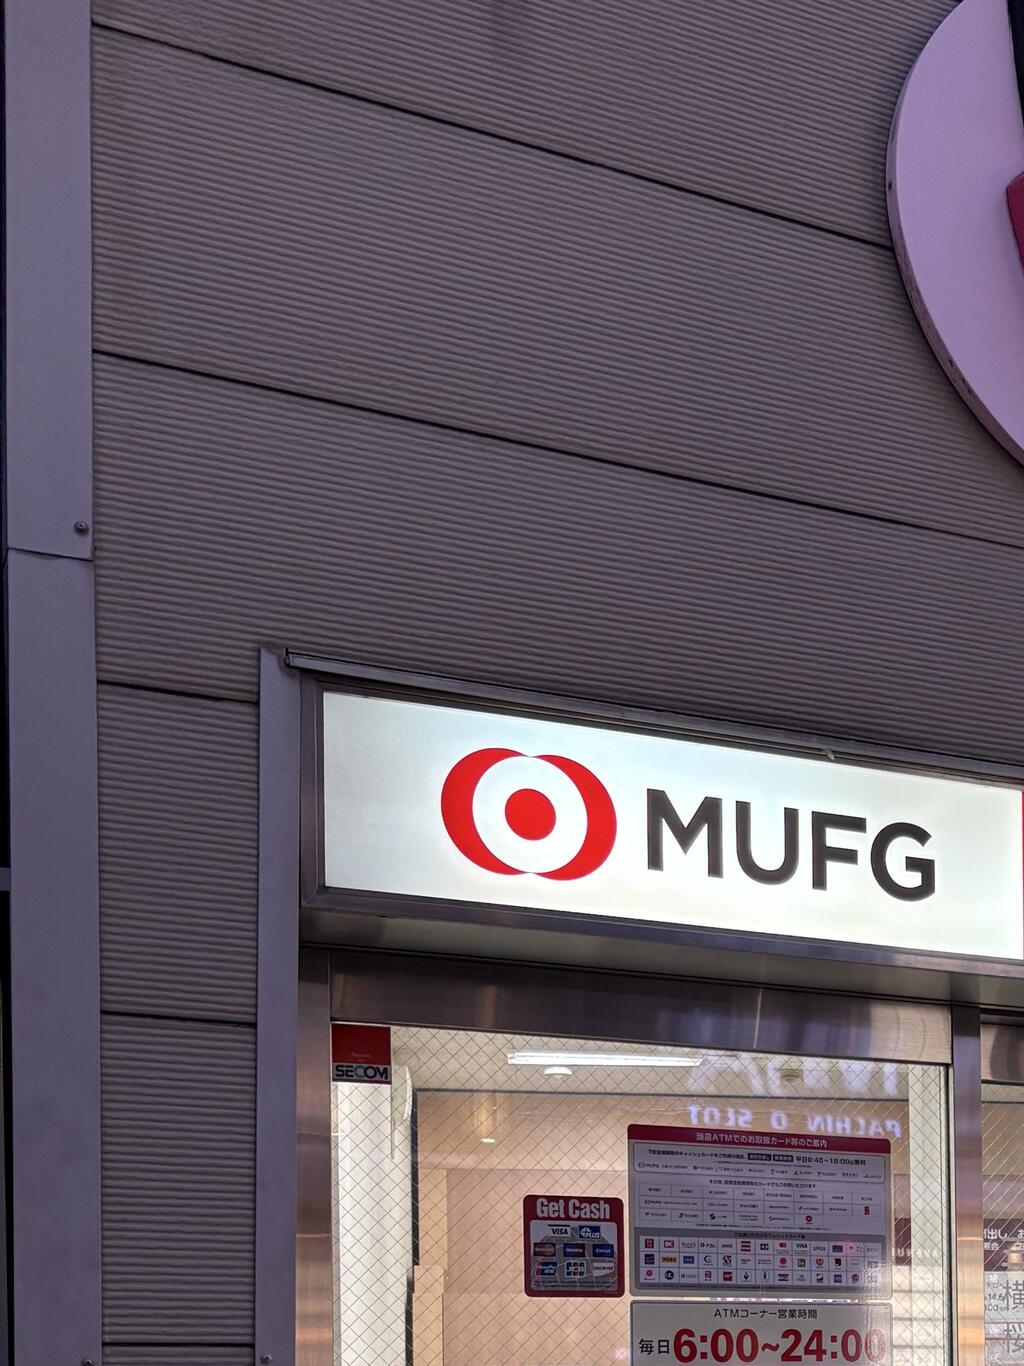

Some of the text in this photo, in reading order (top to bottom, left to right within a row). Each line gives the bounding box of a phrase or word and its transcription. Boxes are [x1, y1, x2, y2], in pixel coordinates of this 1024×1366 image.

[647, 788, 935, 902] MUFG
[335, 1065, 388, 1080] SECOM
[536, 1198, 610, 1219] Get Cash
[713, 1308, 818, 1320] ATMコーナー営業時間
[639, 1338, 670, 1355] 毎日
